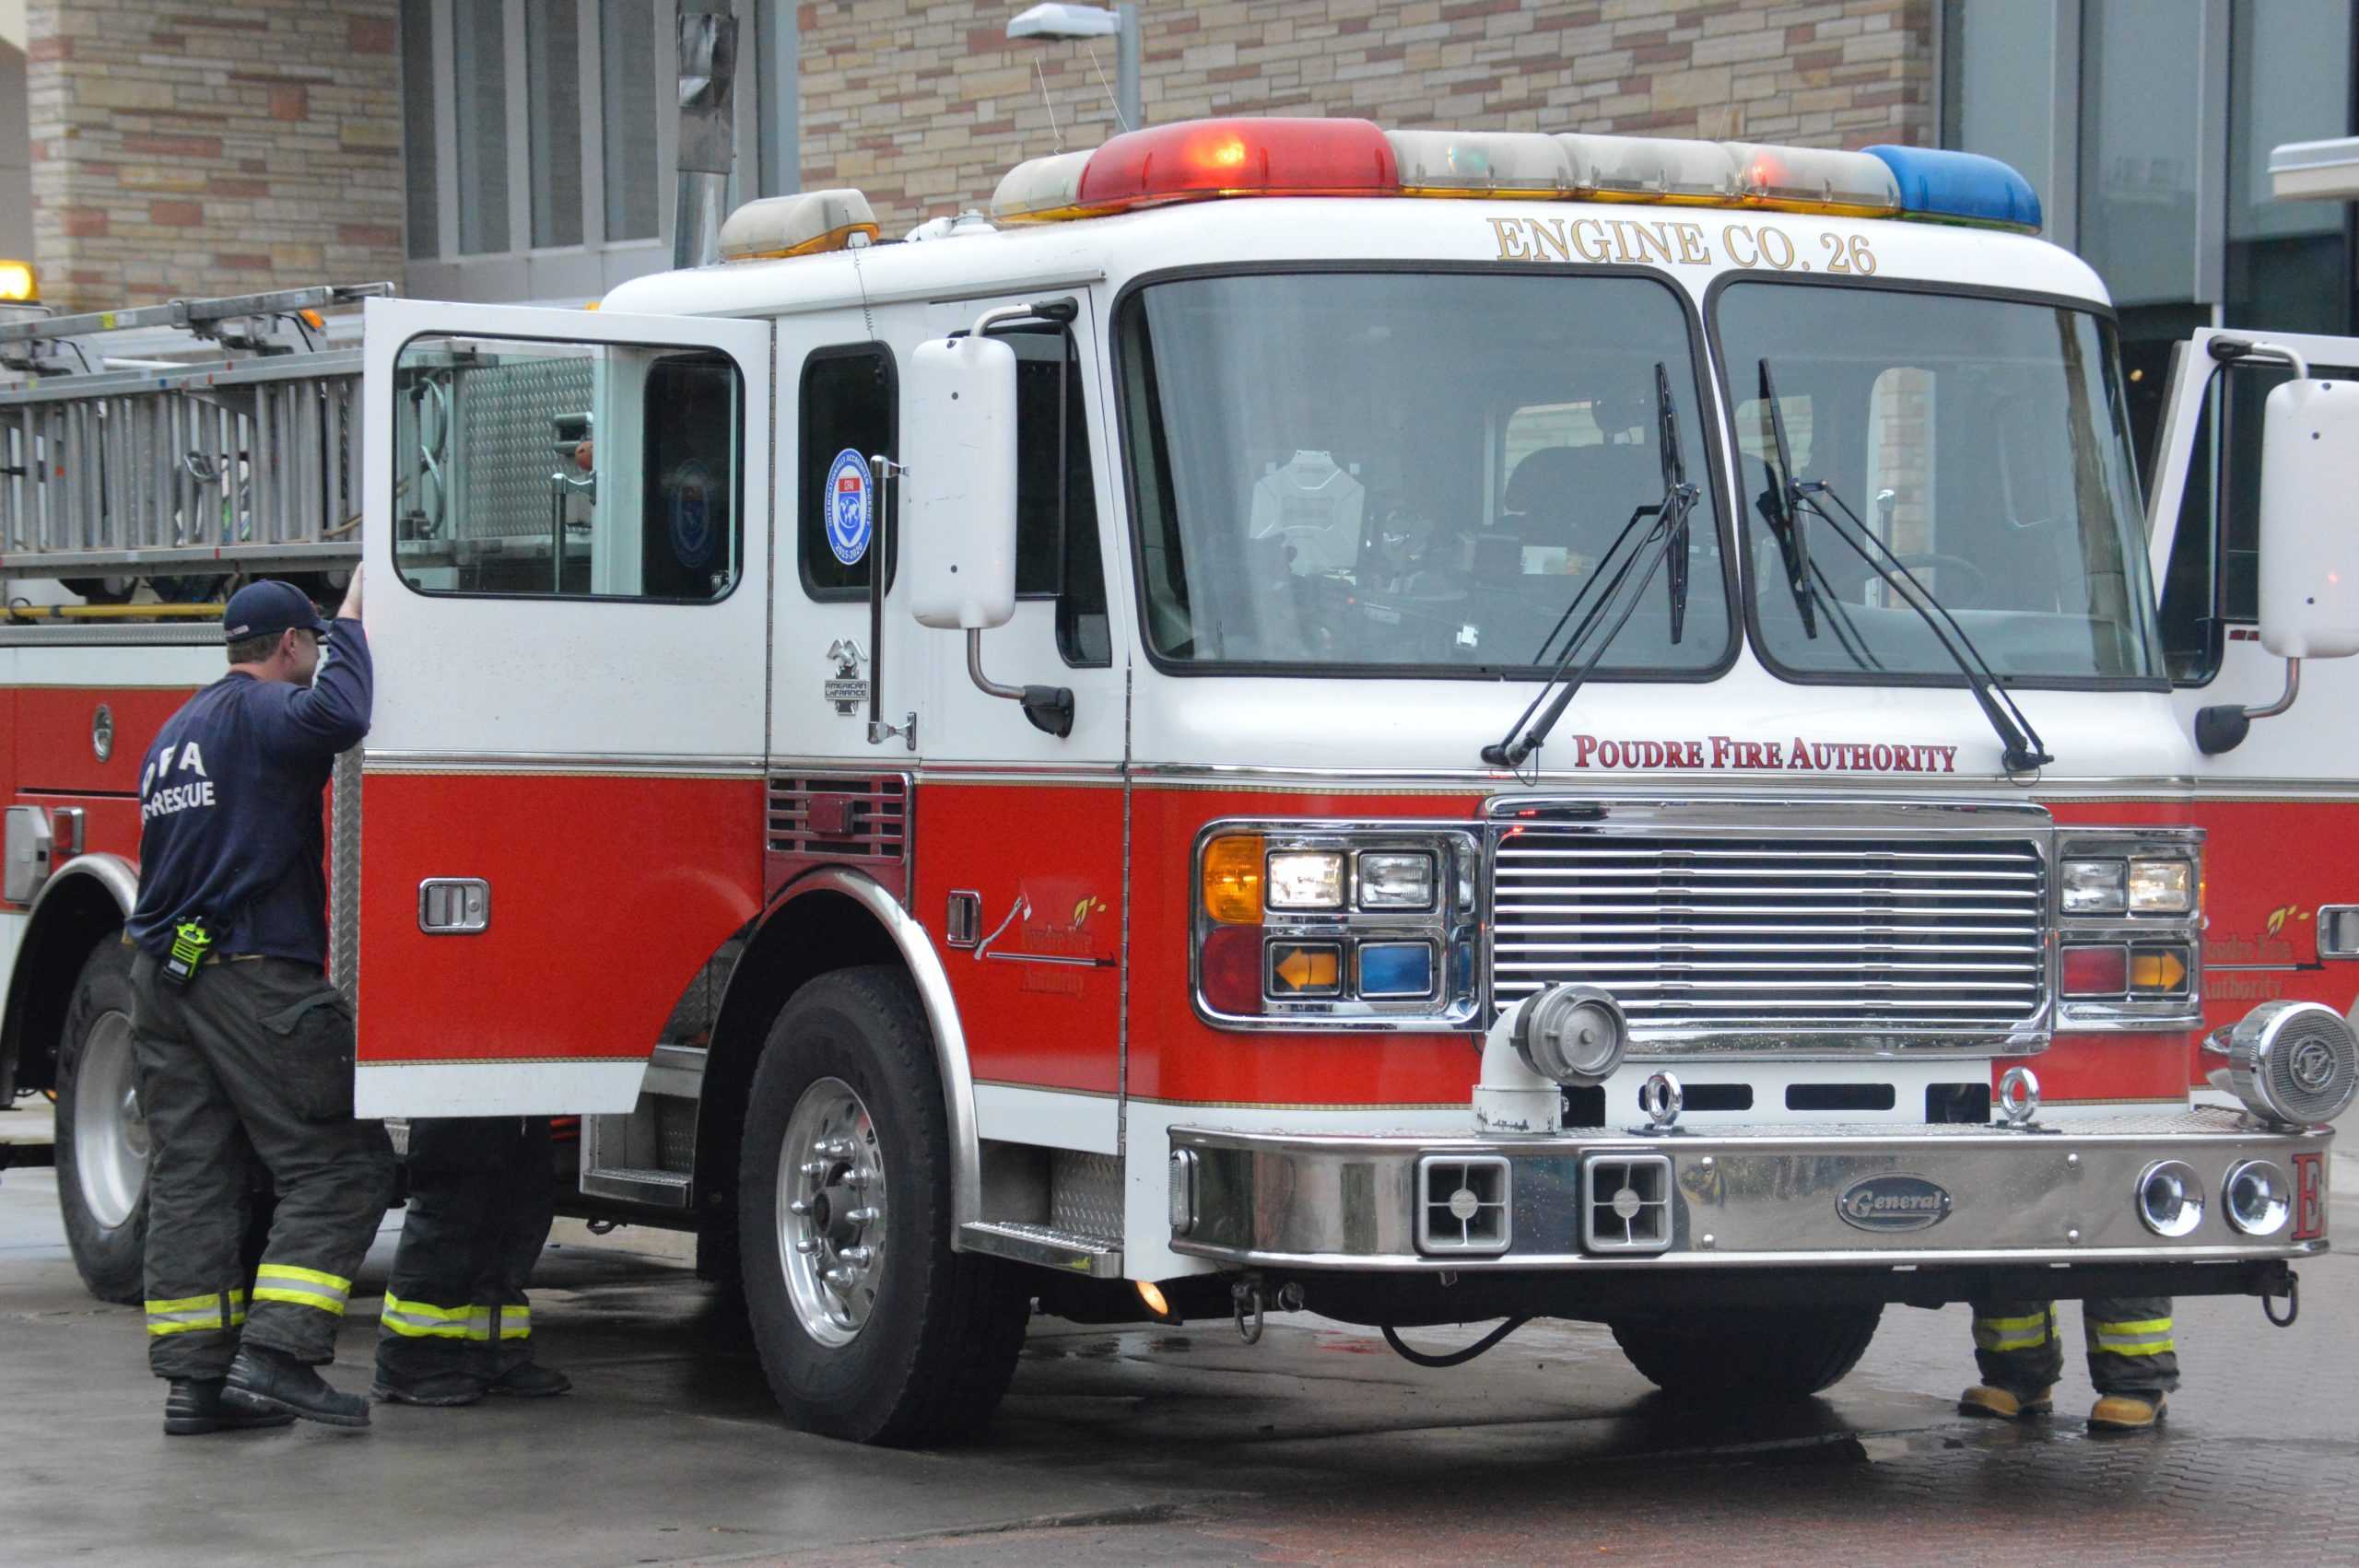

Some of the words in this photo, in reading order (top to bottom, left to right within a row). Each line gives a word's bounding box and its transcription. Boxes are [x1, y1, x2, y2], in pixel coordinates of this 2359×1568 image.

[1486, 217, 1711, 265] ENGINE
[1722, 224, 1811, 272] CO.
[1820, 232, 1877, 275] 26
[1572, 734, 1704, 769] POUDRE
[1708, 735, 1783, 770] FIRE
[1787, 737, 1957, 773] AUTHORITY
[1847, 1189, 1942, 1217] General
